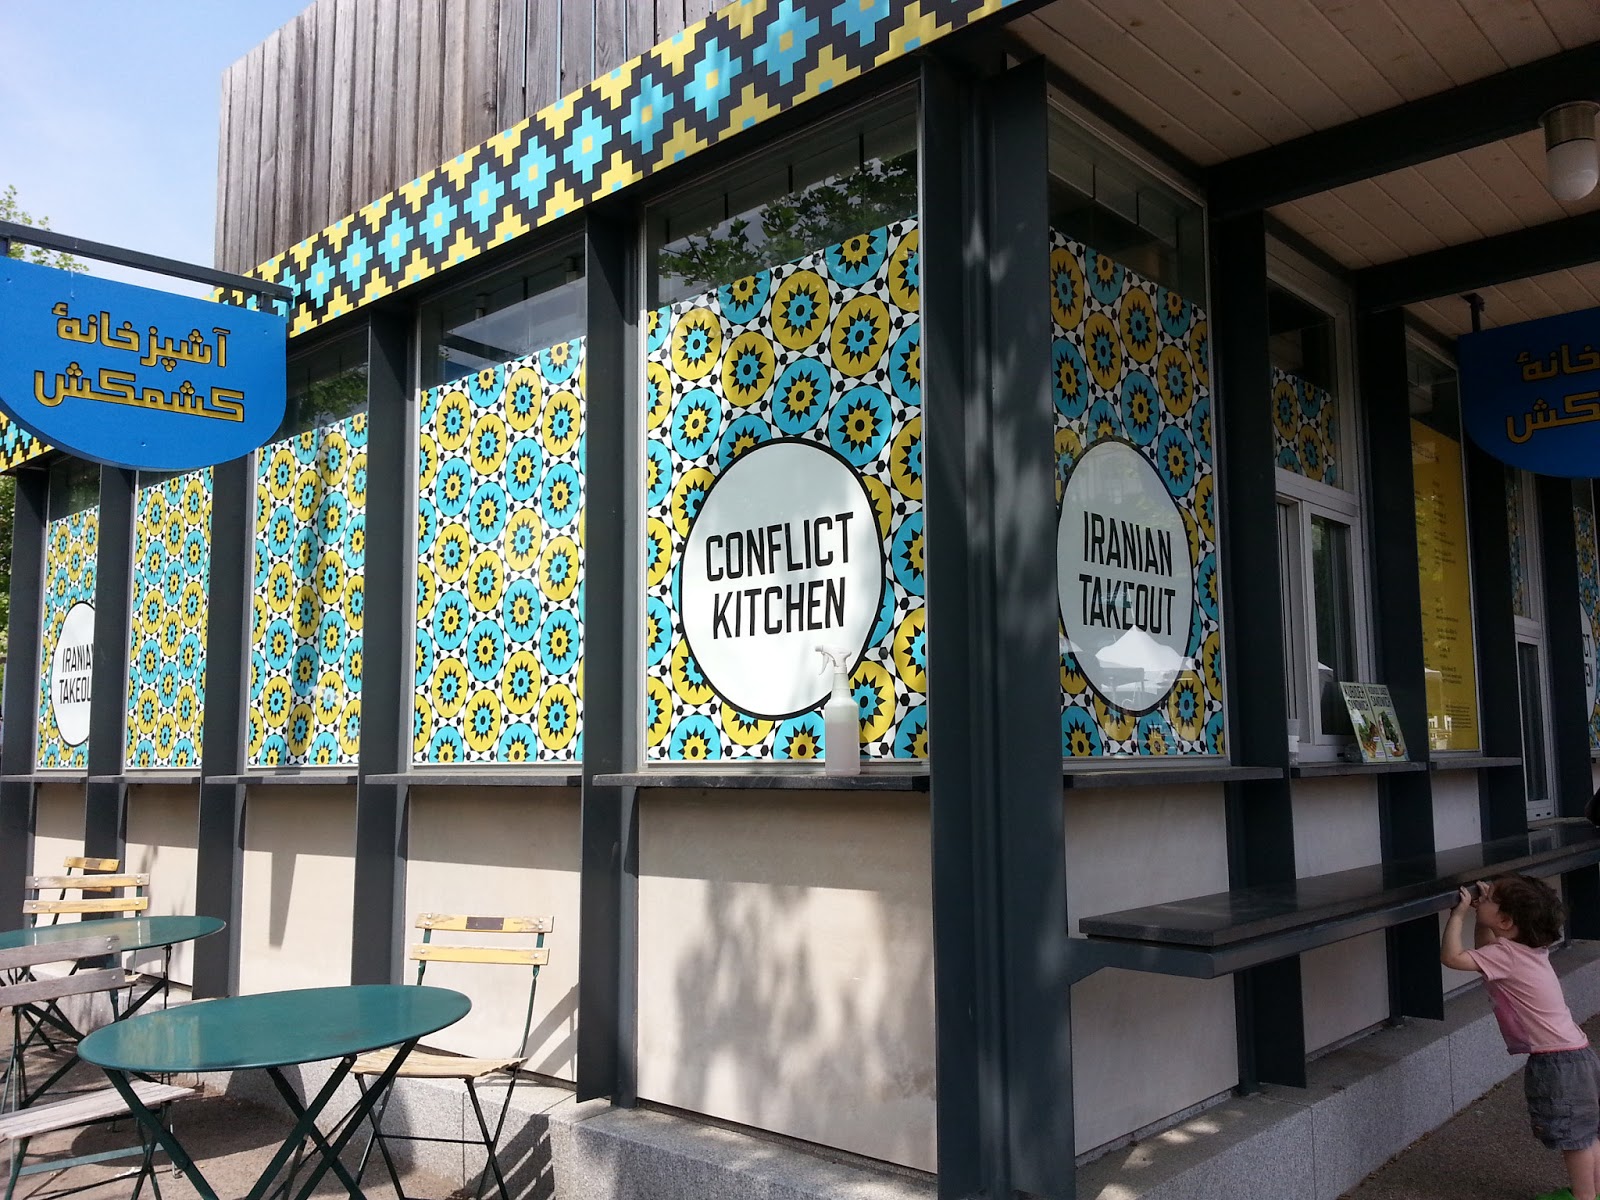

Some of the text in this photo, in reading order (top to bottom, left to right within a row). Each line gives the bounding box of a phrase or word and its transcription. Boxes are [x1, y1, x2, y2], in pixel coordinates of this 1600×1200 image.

[33, 361, 245, 423] کشمکش
[705, 511, 854, 582] CONFLICT
[1083, 511, 1173, 577] IRANIAN
[712, 576, 846, 640] KITCHEN
[1079, 573, 1176, 635] TAKEOUT
[62, 643, 94, 673] IRANIA
[59, 676, 92, 704] TAKEOU
